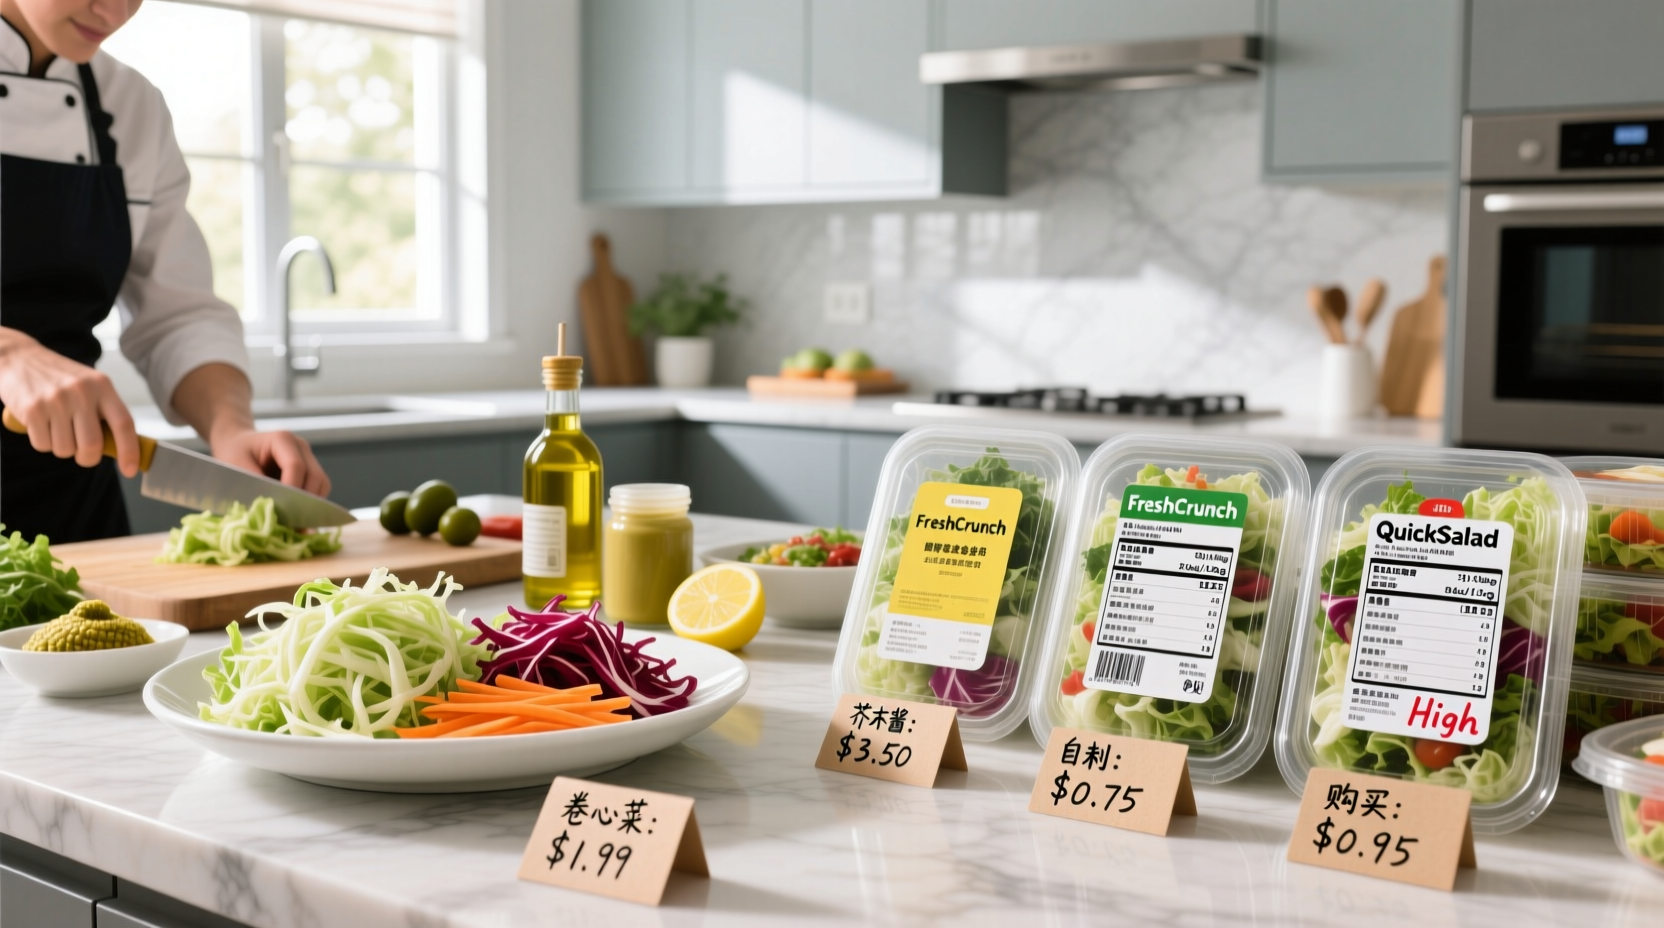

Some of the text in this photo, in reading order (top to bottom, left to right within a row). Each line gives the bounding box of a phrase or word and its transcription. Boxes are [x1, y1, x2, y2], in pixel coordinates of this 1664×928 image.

[915, 514, 1007, 536] FreshCrunch
[1127, 494, 1238, 520] FreshCrunch
[1376, 520, 1499, 548] QuickSalad
[1407, 695, 1479, 739] High
[836, 730, 912, 767] $3.50
[1050, 769, 1144, 813] $0.75
[546, 829, 633, 880] $1.99
[1312, 816, 1419, 867] $0.95
